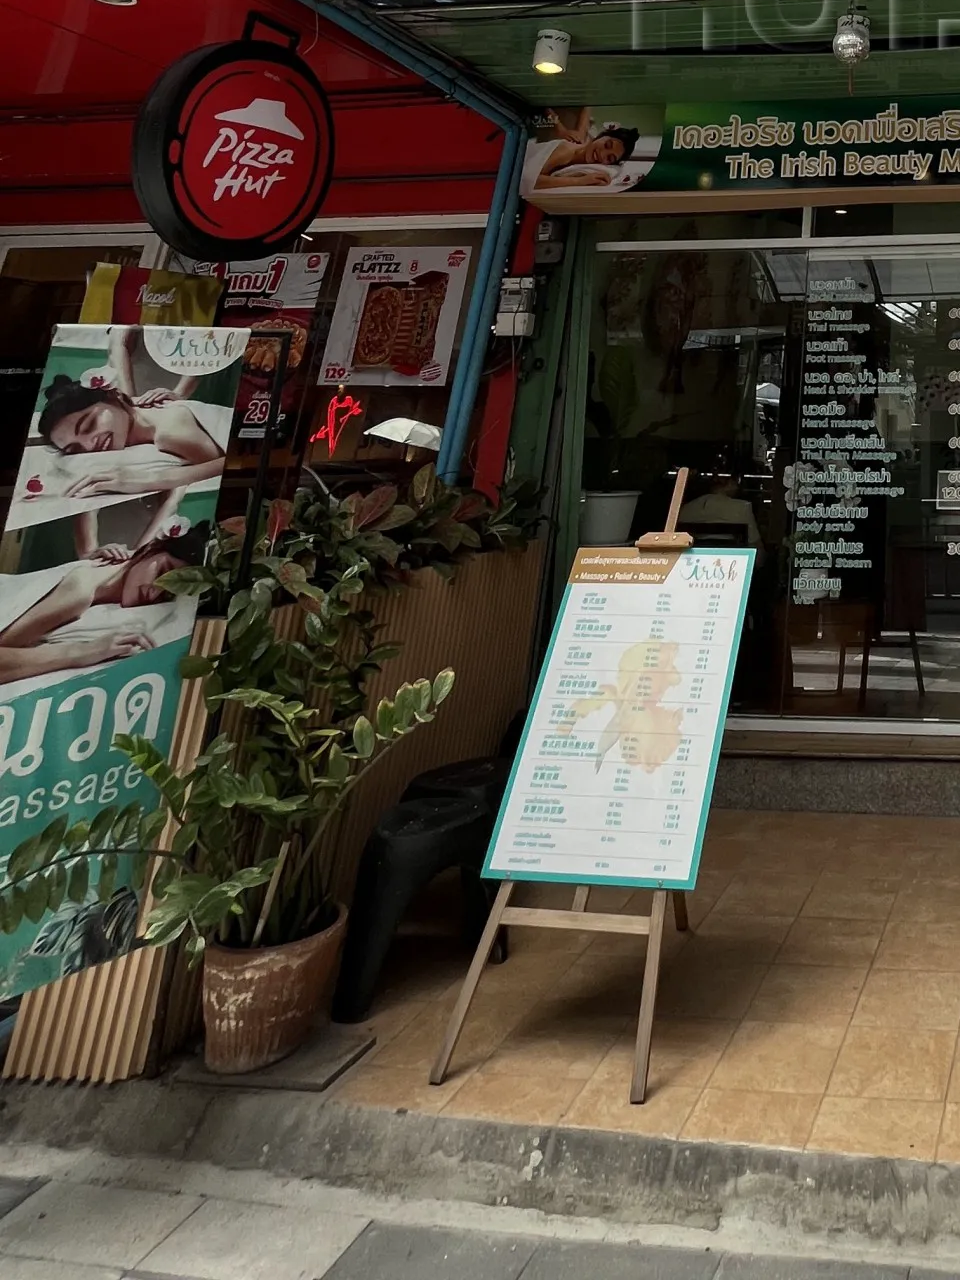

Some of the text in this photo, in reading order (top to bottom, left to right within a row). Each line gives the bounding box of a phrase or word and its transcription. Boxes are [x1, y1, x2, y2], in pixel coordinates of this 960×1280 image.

[673, 115, 796, 150] เดอะไอริช
[202, 127, 295, 169] Pizza
[725, 152, 773, 179] The
[780, 150, 836, 178] Irish
[843, 149, 931, 180] Beauty
[213, 164, 286, 202] Hut
[351, 262, 402, 274] FLATZZ
[808, 307, 853, 320] นวดไทย
[170, 359, 221, 368] MASSAGE
[803, 401, 846, 416] นวดมือ
[802, 418, 875, 430] Hand massage
[856, 487, 905, 498] massage
[796, 521, 856, 534] Body scrub
[794, 557, 872, 568] Herbal Steam
[579, 571, 609, 582] Massage
[638, 572, 661, 582] Beauty
